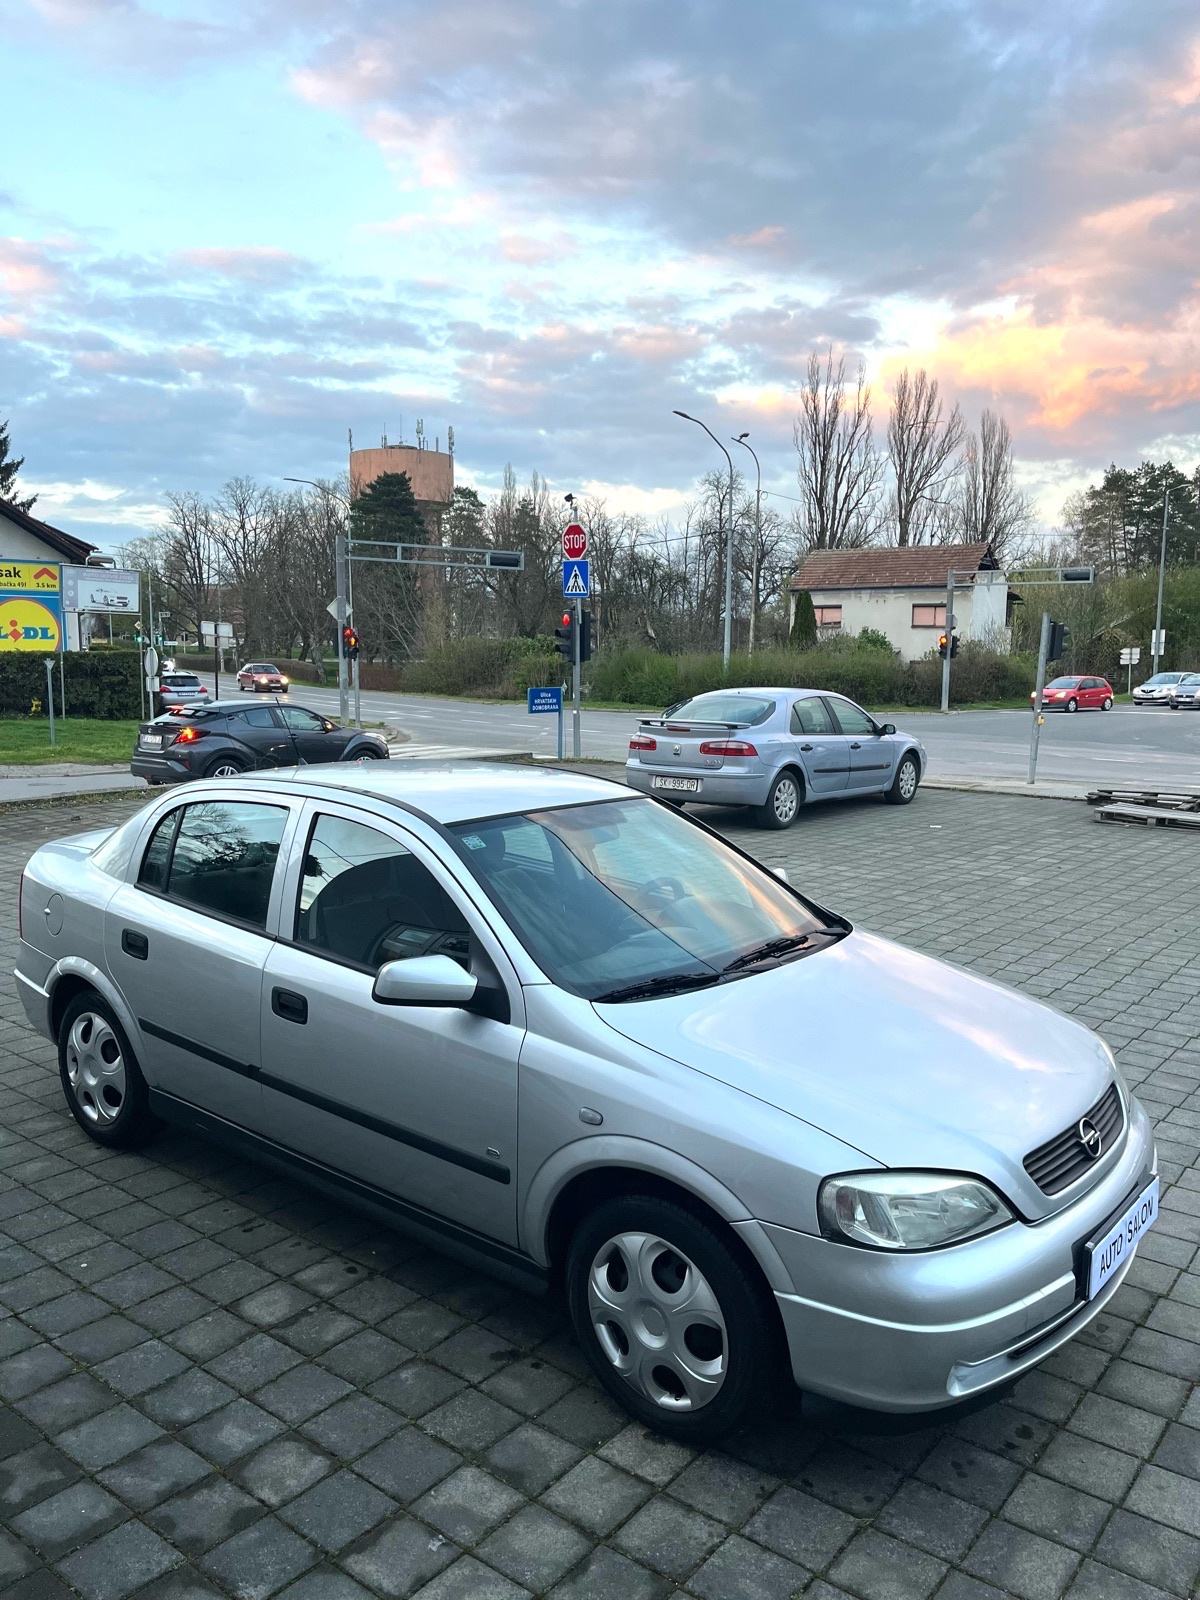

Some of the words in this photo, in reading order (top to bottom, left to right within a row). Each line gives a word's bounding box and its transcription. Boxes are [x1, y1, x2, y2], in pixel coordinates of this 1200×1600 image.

[564, 534, 585, 549] STOP
[660, 777, 668, 787] SK
[1100, 1233, 1123, 1279] AUTO
[1127, 1196, 1154, 1243] SALON
